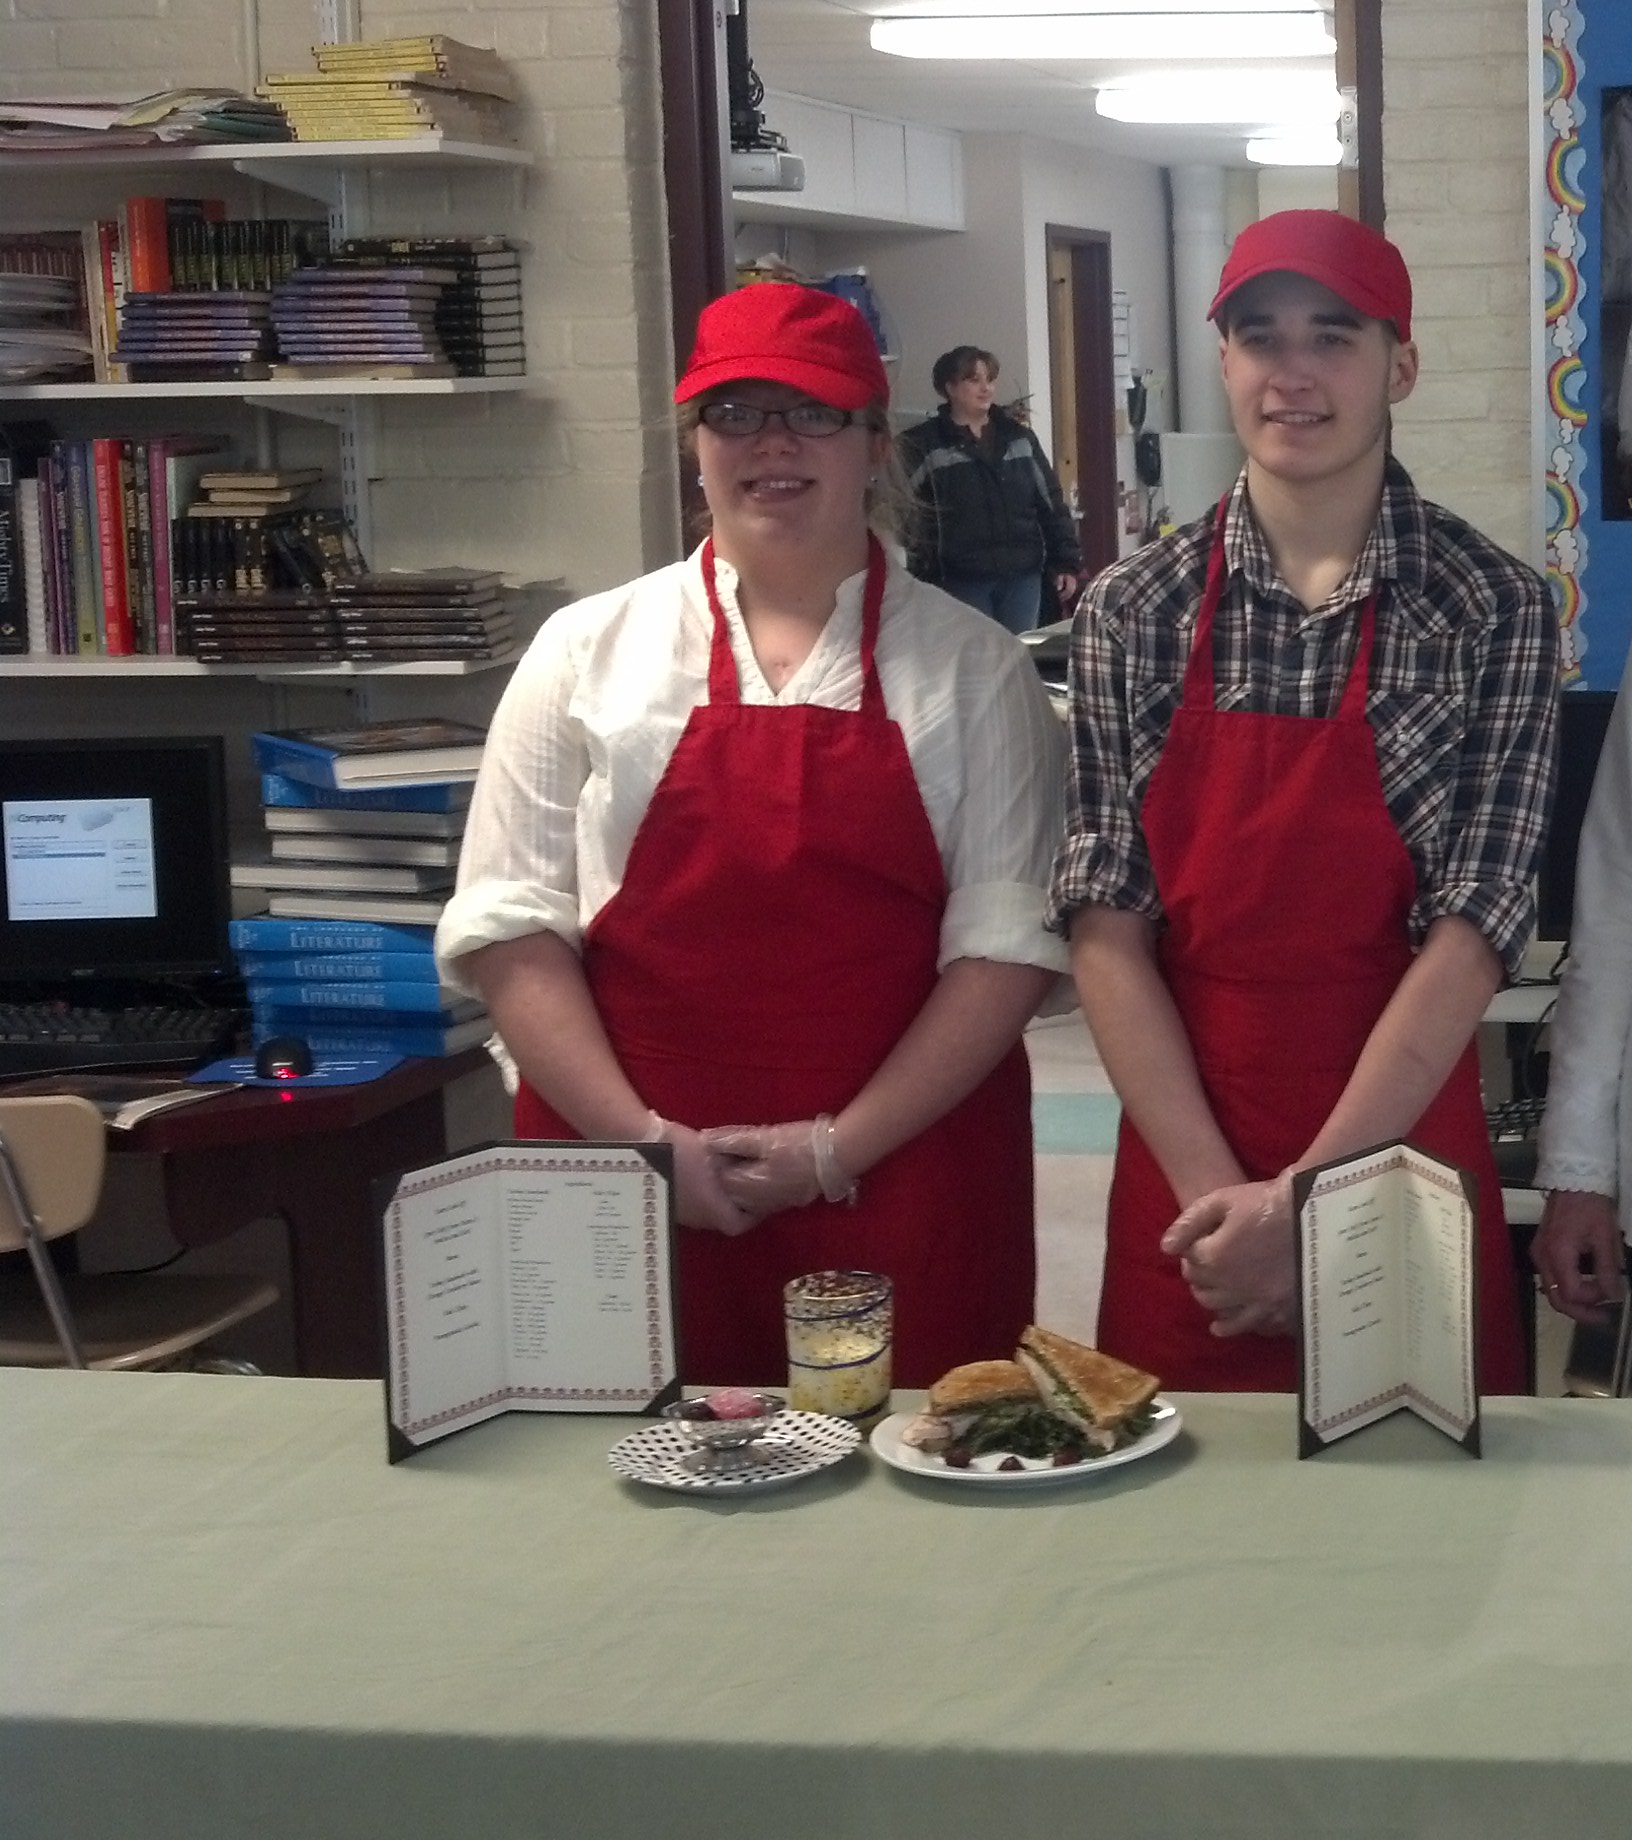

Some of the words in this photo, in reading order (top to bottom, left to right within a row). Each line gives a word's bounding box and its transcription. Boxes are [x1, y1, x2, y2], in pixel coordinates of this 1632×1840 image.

[290, 932, 384, 949] LITERATURE
[294, 960, 382, 978] LITERATURE
[301, 988, 385, 1006] LITERATURE
